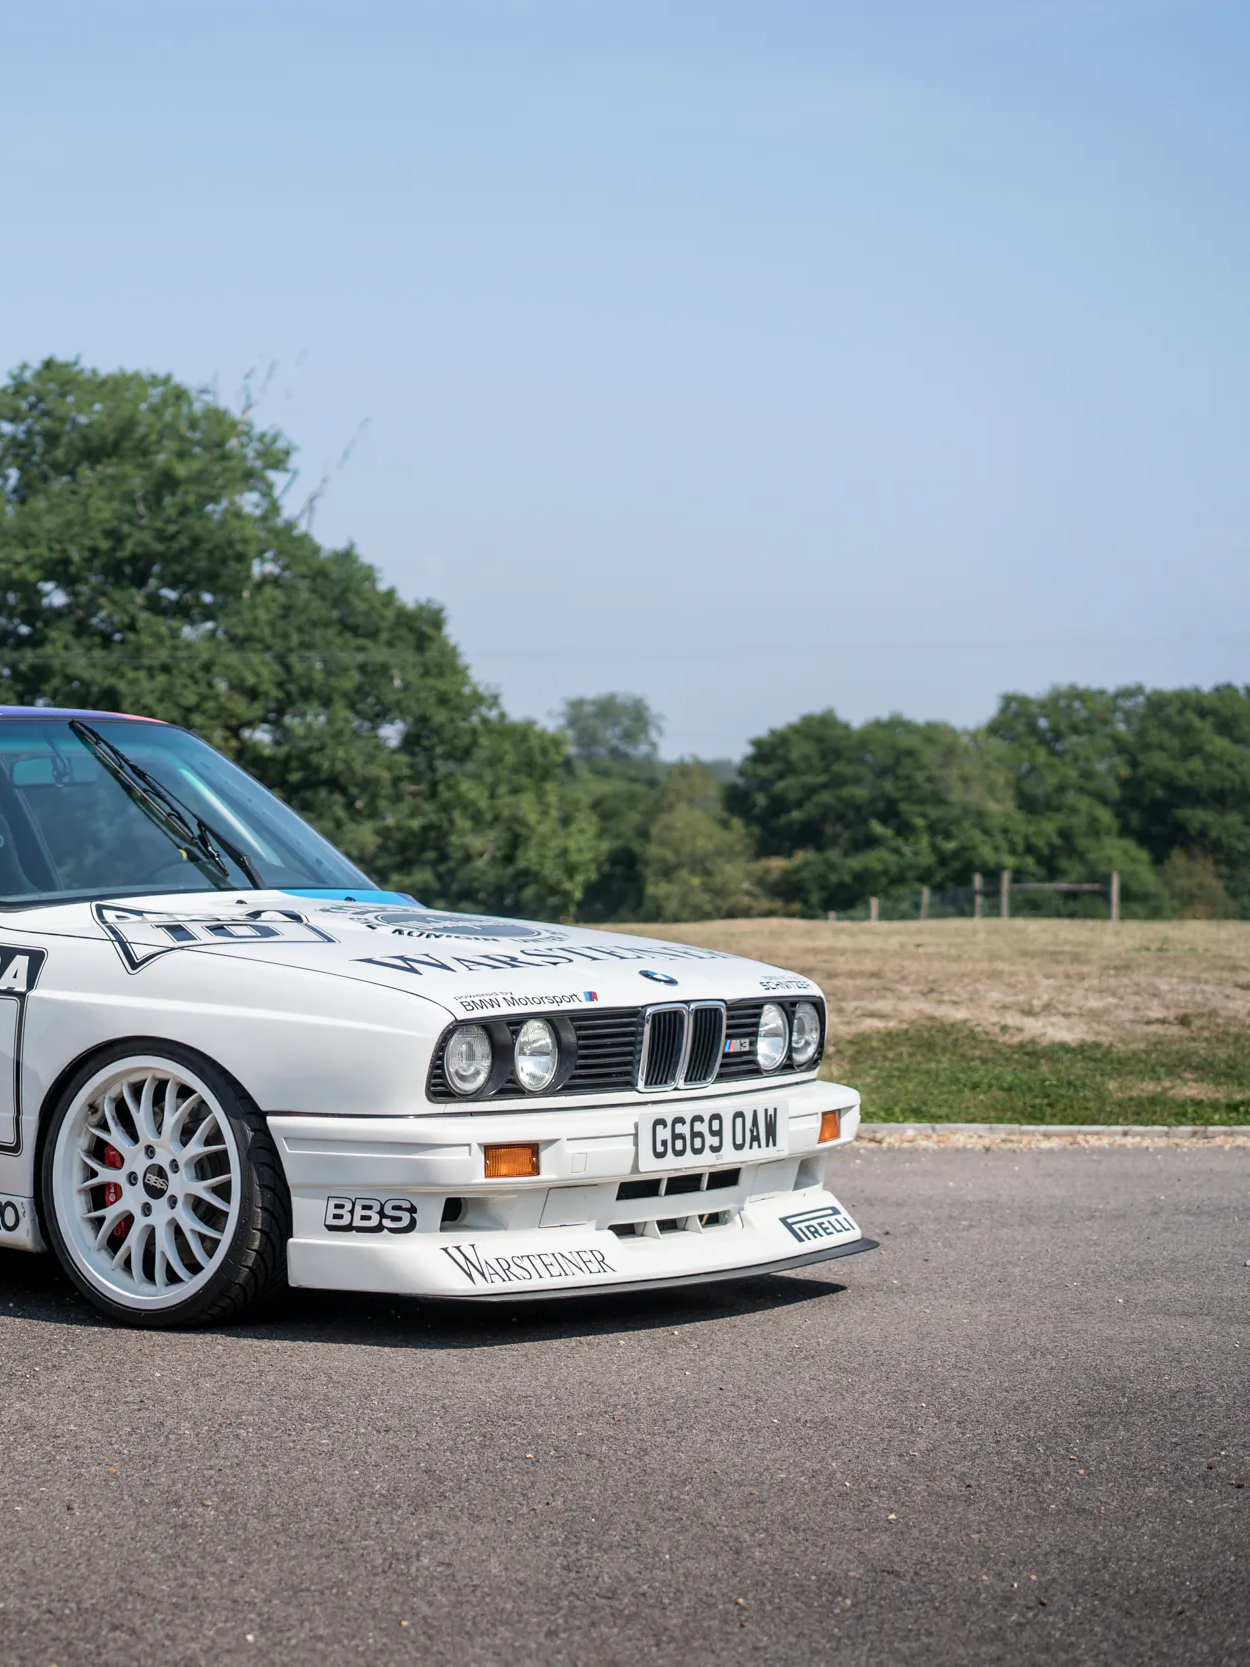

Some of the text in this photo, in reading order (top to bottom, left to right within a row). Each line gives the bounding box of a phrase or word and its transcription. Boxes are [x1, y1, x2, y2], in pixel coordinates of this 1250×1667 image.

[459, 993, 583, 1012] BMW Motorsport
[652, 1107, 778, 1159] G669 OAW
[145, 1173, 169, 1191] BBS
[323, 1195, 418, 1234] BBS
[777, 1206, 856, 1243] PIRELLI
[439, 1243, 618, 1286] WARSTEINER
